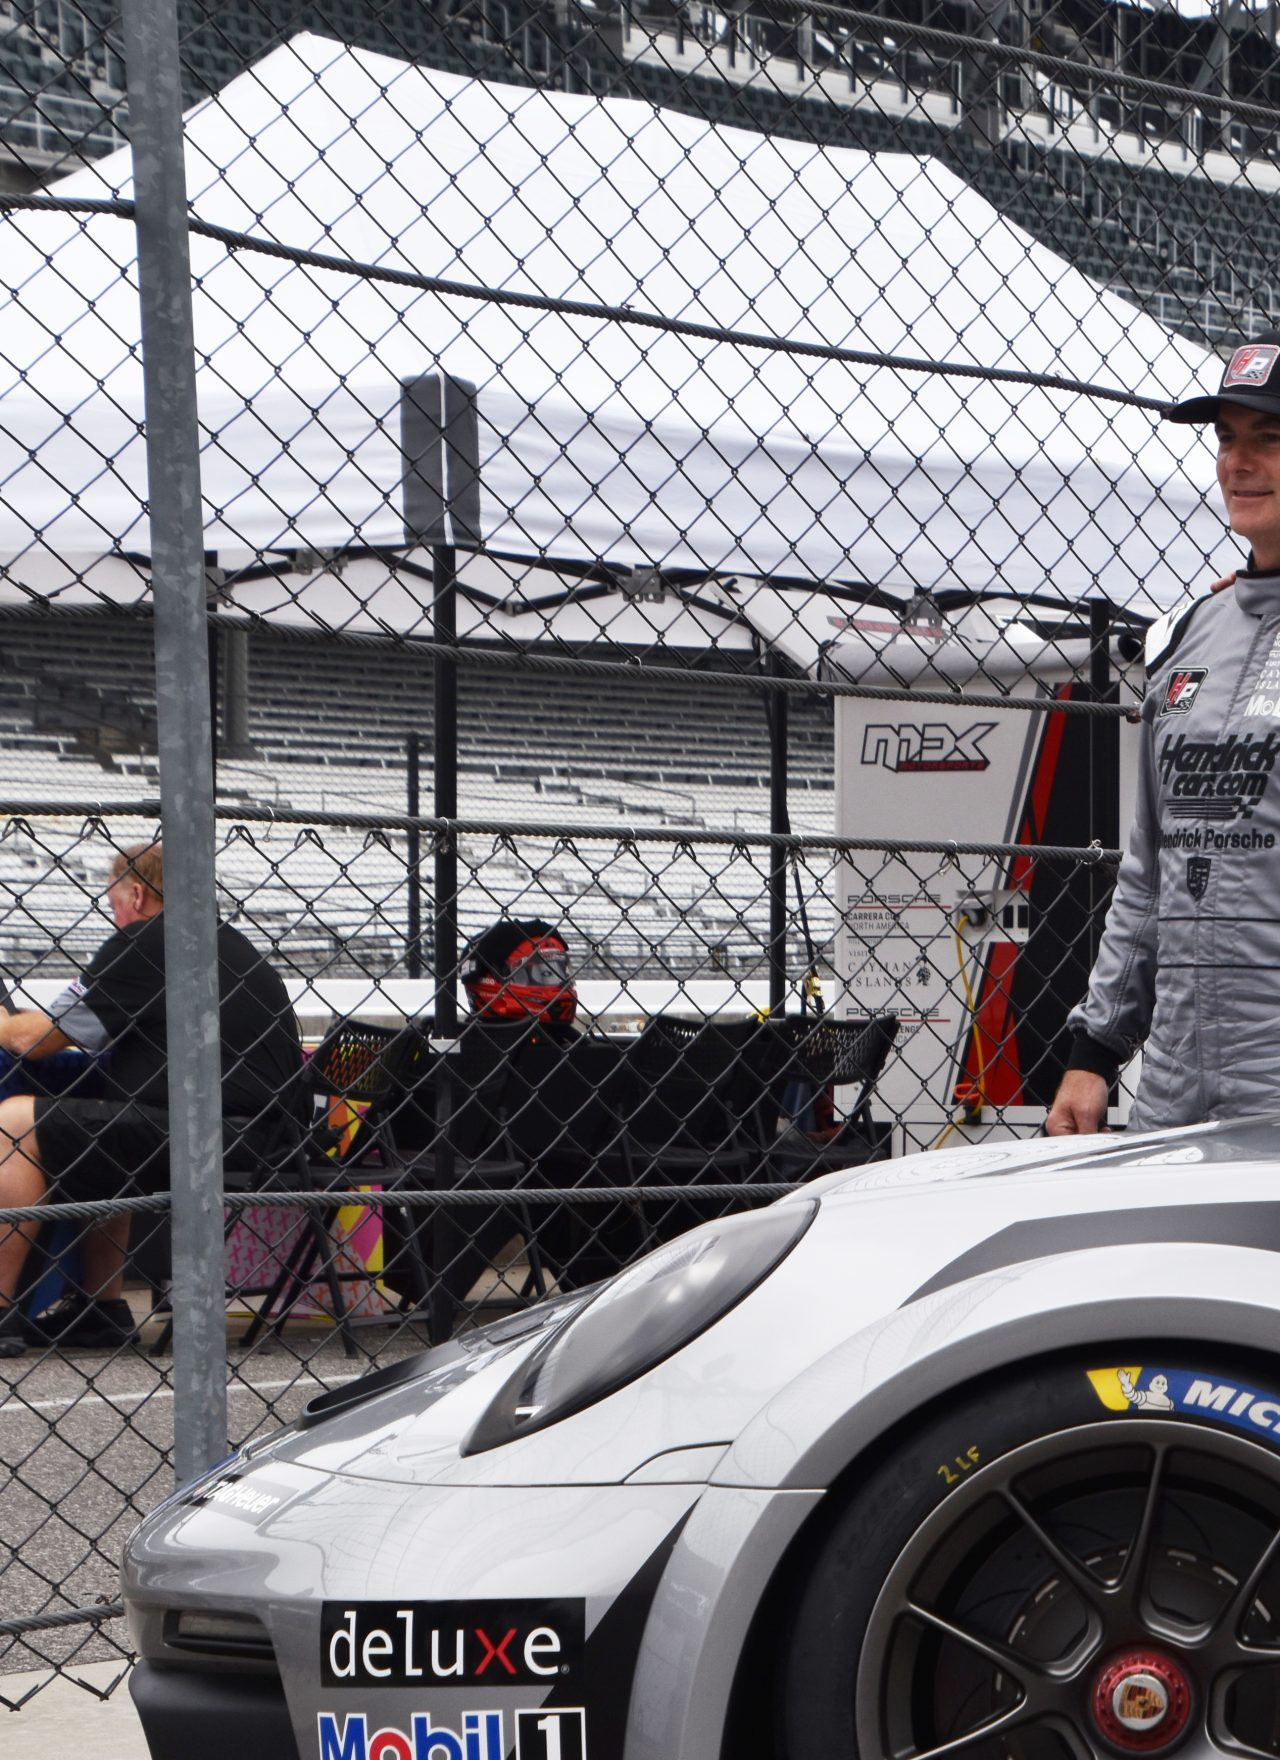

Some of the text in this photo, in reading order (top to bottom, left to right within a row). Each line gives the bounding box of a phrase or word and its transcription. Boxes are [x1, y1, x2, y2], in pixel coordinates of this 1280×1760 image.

[1204, 828, 1276, 849] Porsche
[847, 894, 941, 904] PORSCHE
[848, 912, 884, 921] CARRERA
[329, 1610, 561, 1678] deluxe
[317, 1709, 504, 1760] Mobil
